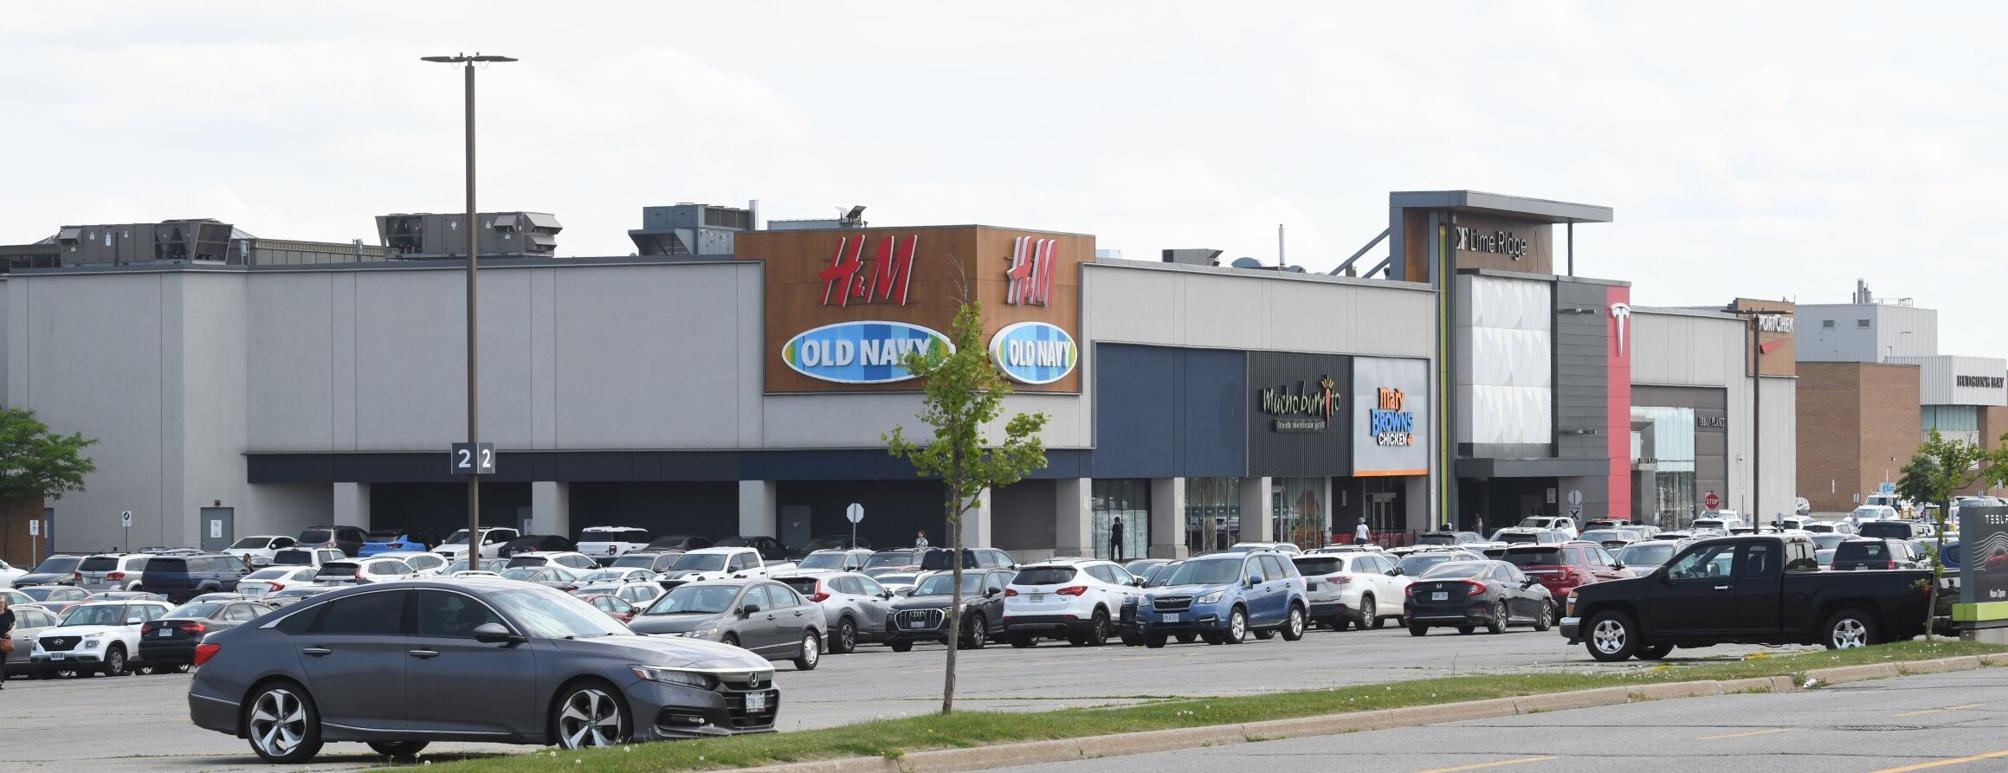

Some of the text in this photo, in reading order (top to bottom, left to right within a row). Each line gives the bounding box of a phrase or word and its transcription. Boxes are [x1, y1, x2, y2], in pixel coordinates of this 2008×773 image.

[1471, 228, 1495, 253] Lime
[1499, 231, 1527, 261] Ridge
[819, 234, 917, 307] H&M
[1007, 236, 1056, 307] H&M
[1753, 314, 1793, 333] PORTCHEK
[801, 338, 854, 367] OLD
[1009, 339, 1071, 367] OLD NAVY
[1378, 433, 1408, 446] CHICKEN
[458, 448, 471, 468] 2
[482, 448, 491, 468] 2
